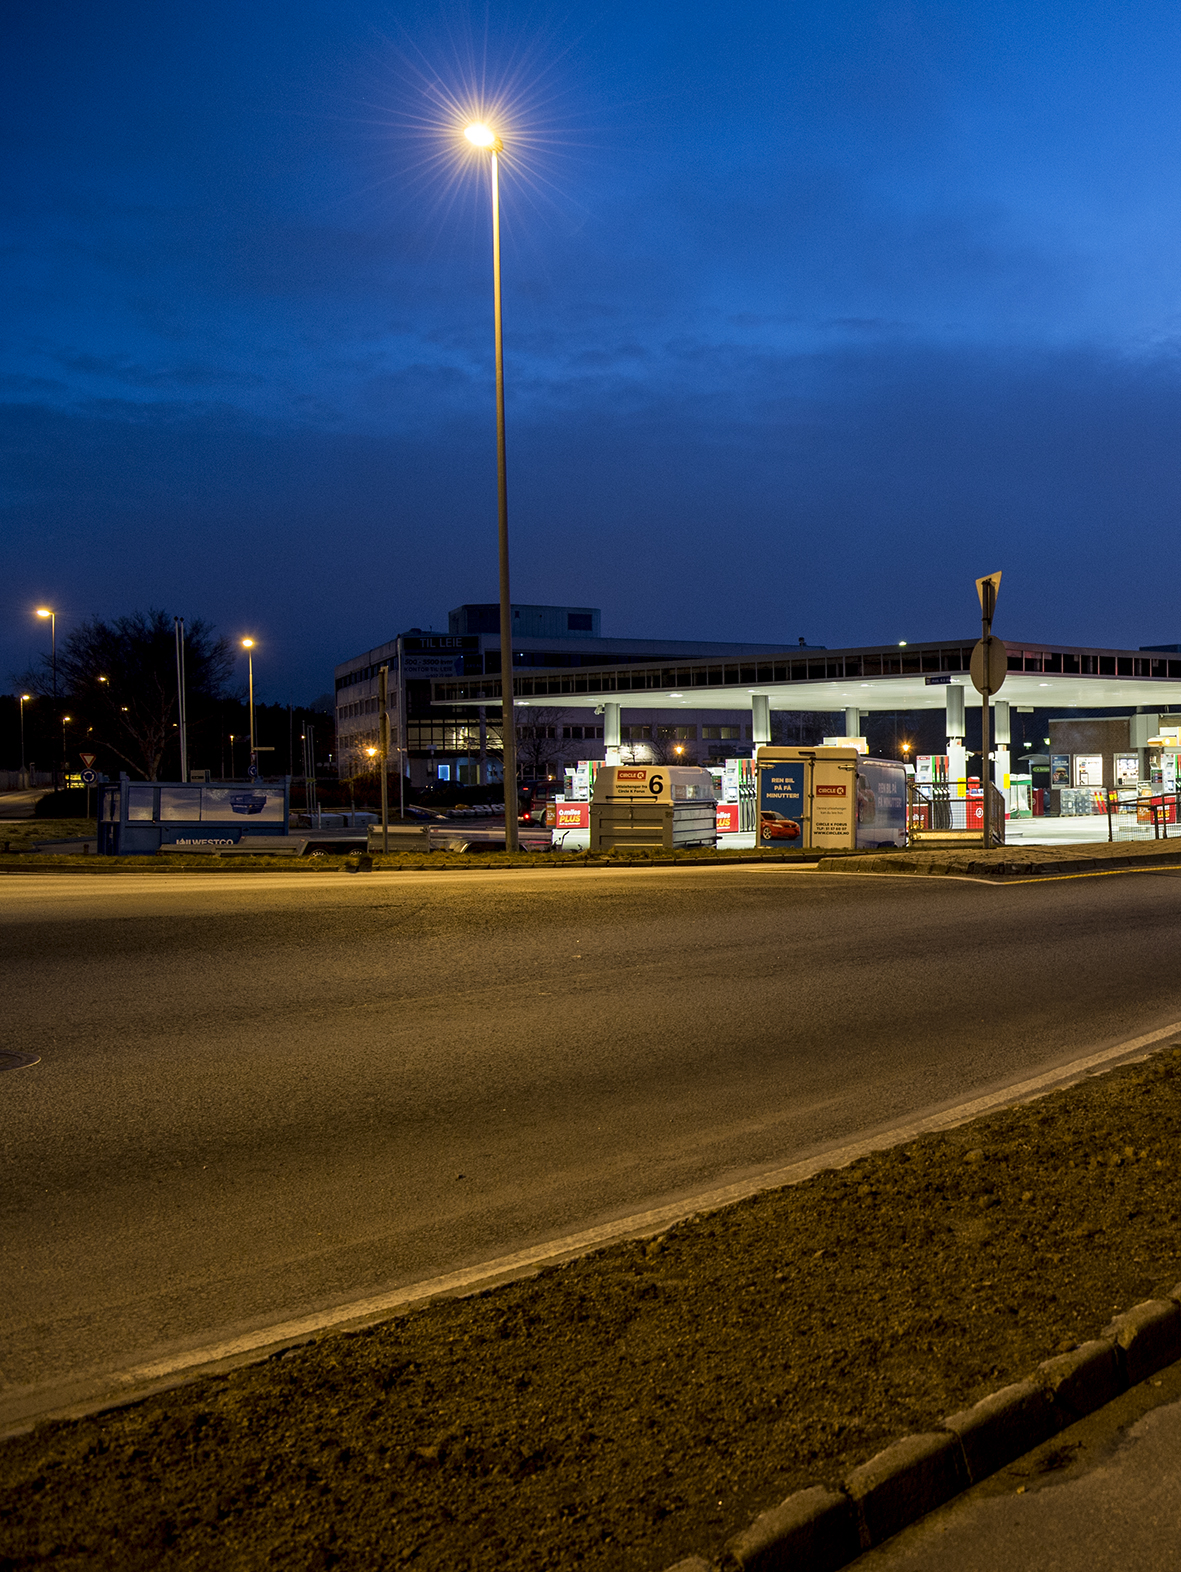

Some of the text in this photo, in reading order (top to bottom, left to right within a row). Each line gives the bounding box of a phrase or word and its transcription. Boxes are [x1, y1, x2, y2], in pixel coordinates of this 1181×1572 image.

[420, 638, 462, 648] TIL LEIE
[649, 775, 663, 794] 6
